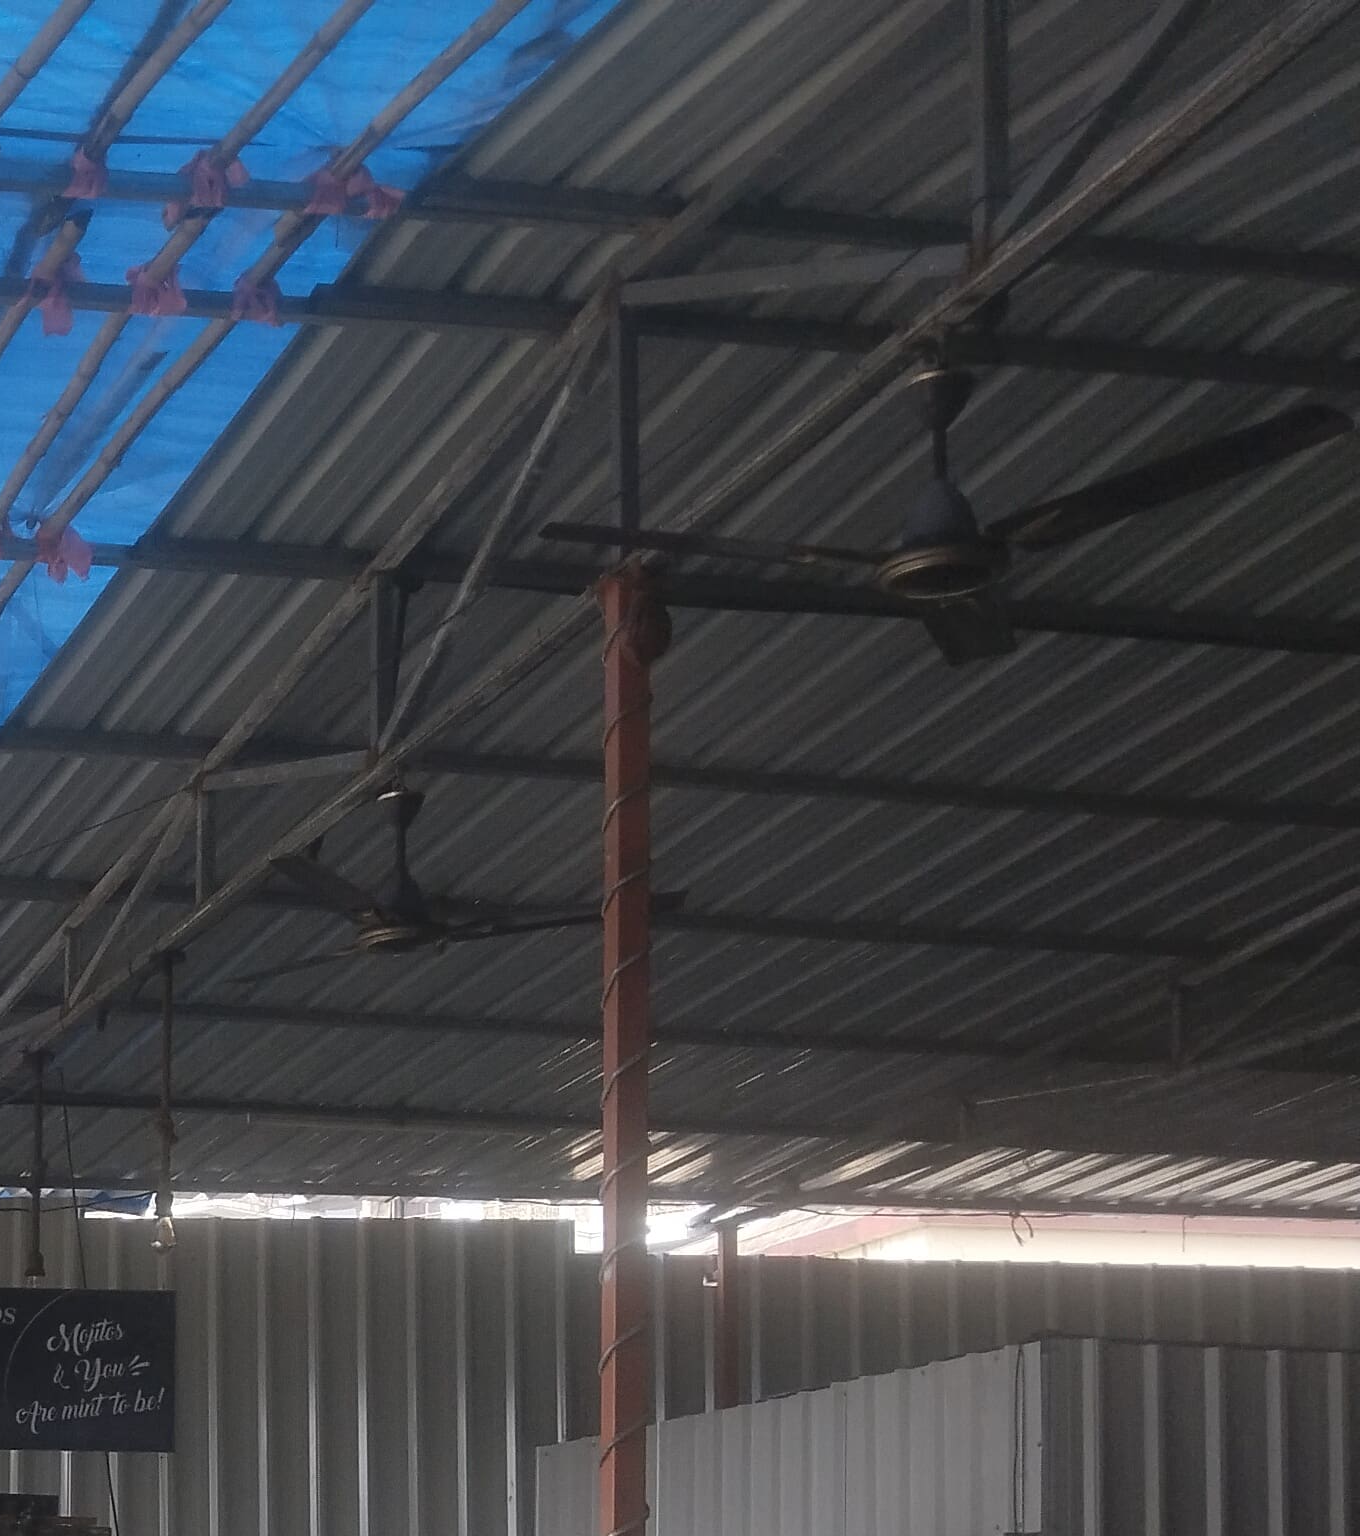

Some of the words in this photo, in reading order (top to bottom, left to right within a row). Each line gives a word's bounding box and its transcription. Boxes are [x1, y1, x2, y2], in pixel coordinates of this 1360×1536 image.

[47, 1318, 124, 1356] Mojitos
[74, 1357, 126, 1392] You
[16, 1400, 57, 1435] Are
[62, 1394, 107, 1420] mint
[109, 1392, 130, 1415] to
[134, 1387, 165, 1413] be!
